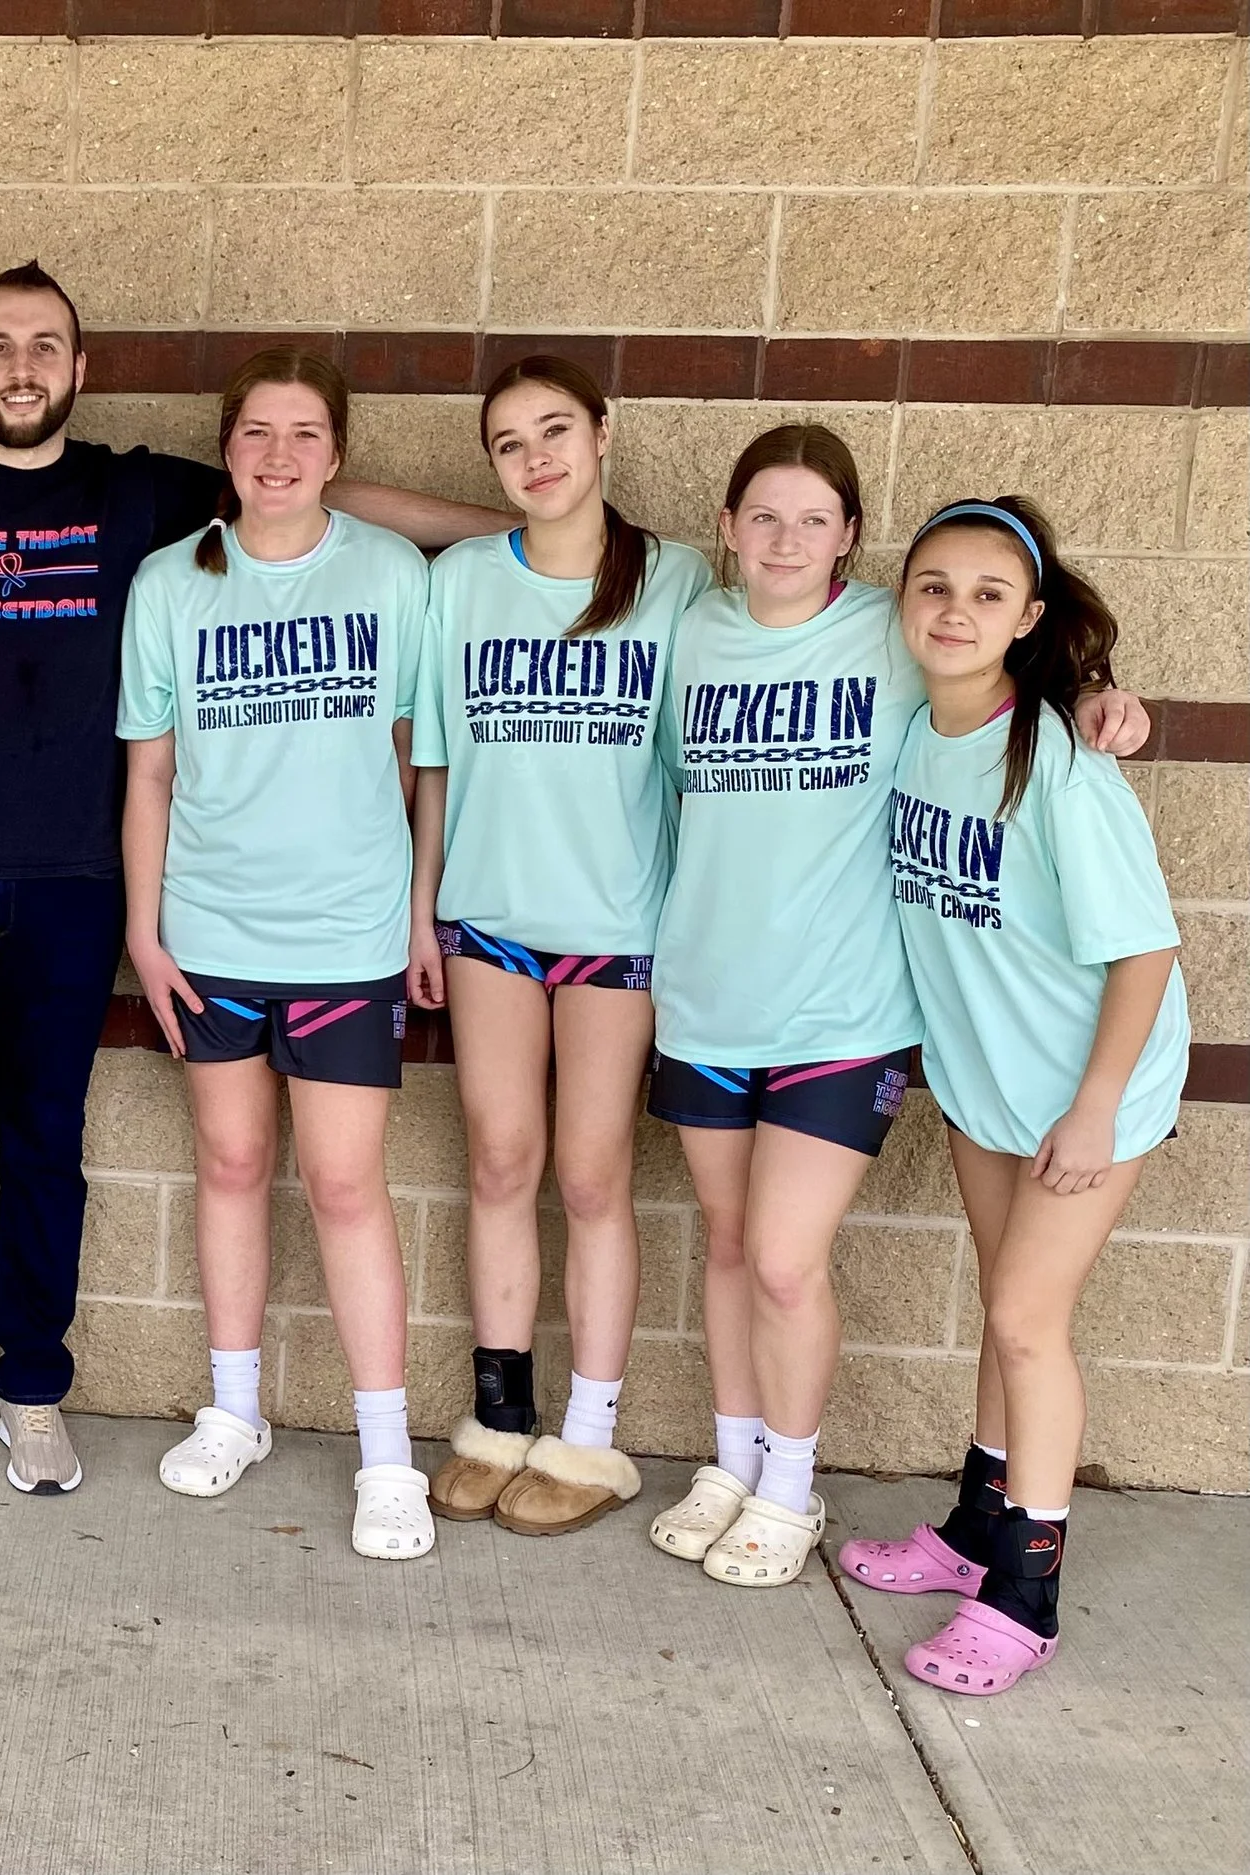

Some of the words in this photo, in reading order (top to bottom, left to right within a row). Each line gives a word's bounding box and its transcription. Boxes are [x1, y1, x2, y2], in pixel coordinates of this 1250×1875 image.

[16, 525, 98, 550] THREAT
[196, 615, 336, 684] LOCKED
[344, 613, 378, 671] IN
[464, 638, 606, 700] LOCKED
[618, 640, 657, 700] IN
[197, 697, 320, 730] BBALLSHOOTOUT
[324, 695, 376, 718] CHAMPS
[683, 680, 818, 744] LOCKED
[830, 676, 877, 740] IN
[587, 721, 645, 746] CHAMPS
[799, 762, 870, 790] CHAMPS
[958, 815, 1005, 881] IN
[941, 894, 1001, 929] CHMPS
